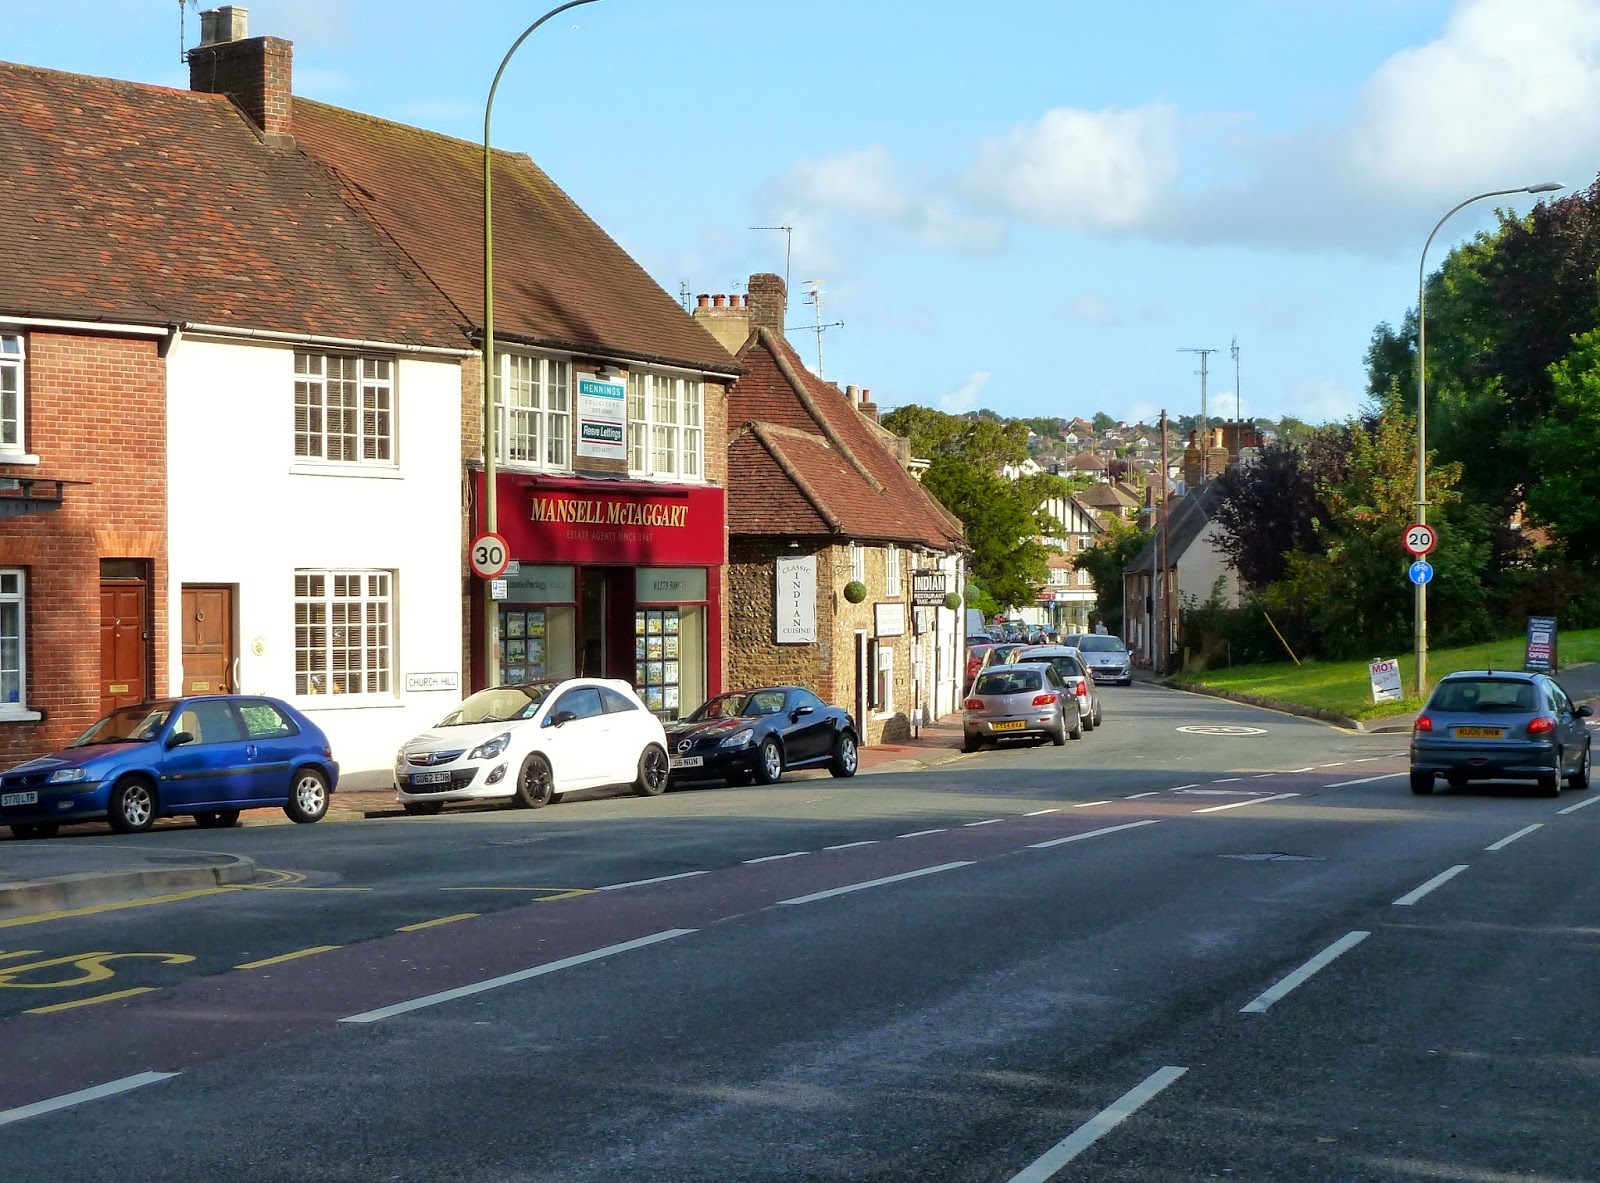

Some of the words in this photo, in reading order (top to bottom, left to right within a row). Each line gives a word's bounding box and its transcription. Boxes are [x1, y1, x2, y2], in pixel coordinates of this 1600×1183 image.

[583, 383, 621, 397] HENNINGS
[584, 399, 620, 408] SOLICITORS
[583, 425, 600, 437] Reeve
[601, 426, 622, 440] Lettings
[531, 498, 604, 524] MANSELL
[606, 501, 688, 528] McTAGGART
[566, 530, 589, 540] ESTATE
[591, 531, 616, 542] AGENTS
[618, 532, 636, 542] SINCE
[1409, 533, 1430, 546] 20
[475, 546, 503, 565] 30
[782, 564, 812, 575] CLASSIC
[914, 575, 945, 591] INDIAN
[793, 572, 801, 626] INDIAN
[1372, 661, 1395, 674] MOT
[409, 678, 438, 687] CHURCH
[441, 677, 456, 686] HILL
[435, 773, 450, 782] EDR
[21, 792, 35, 803] LTR
